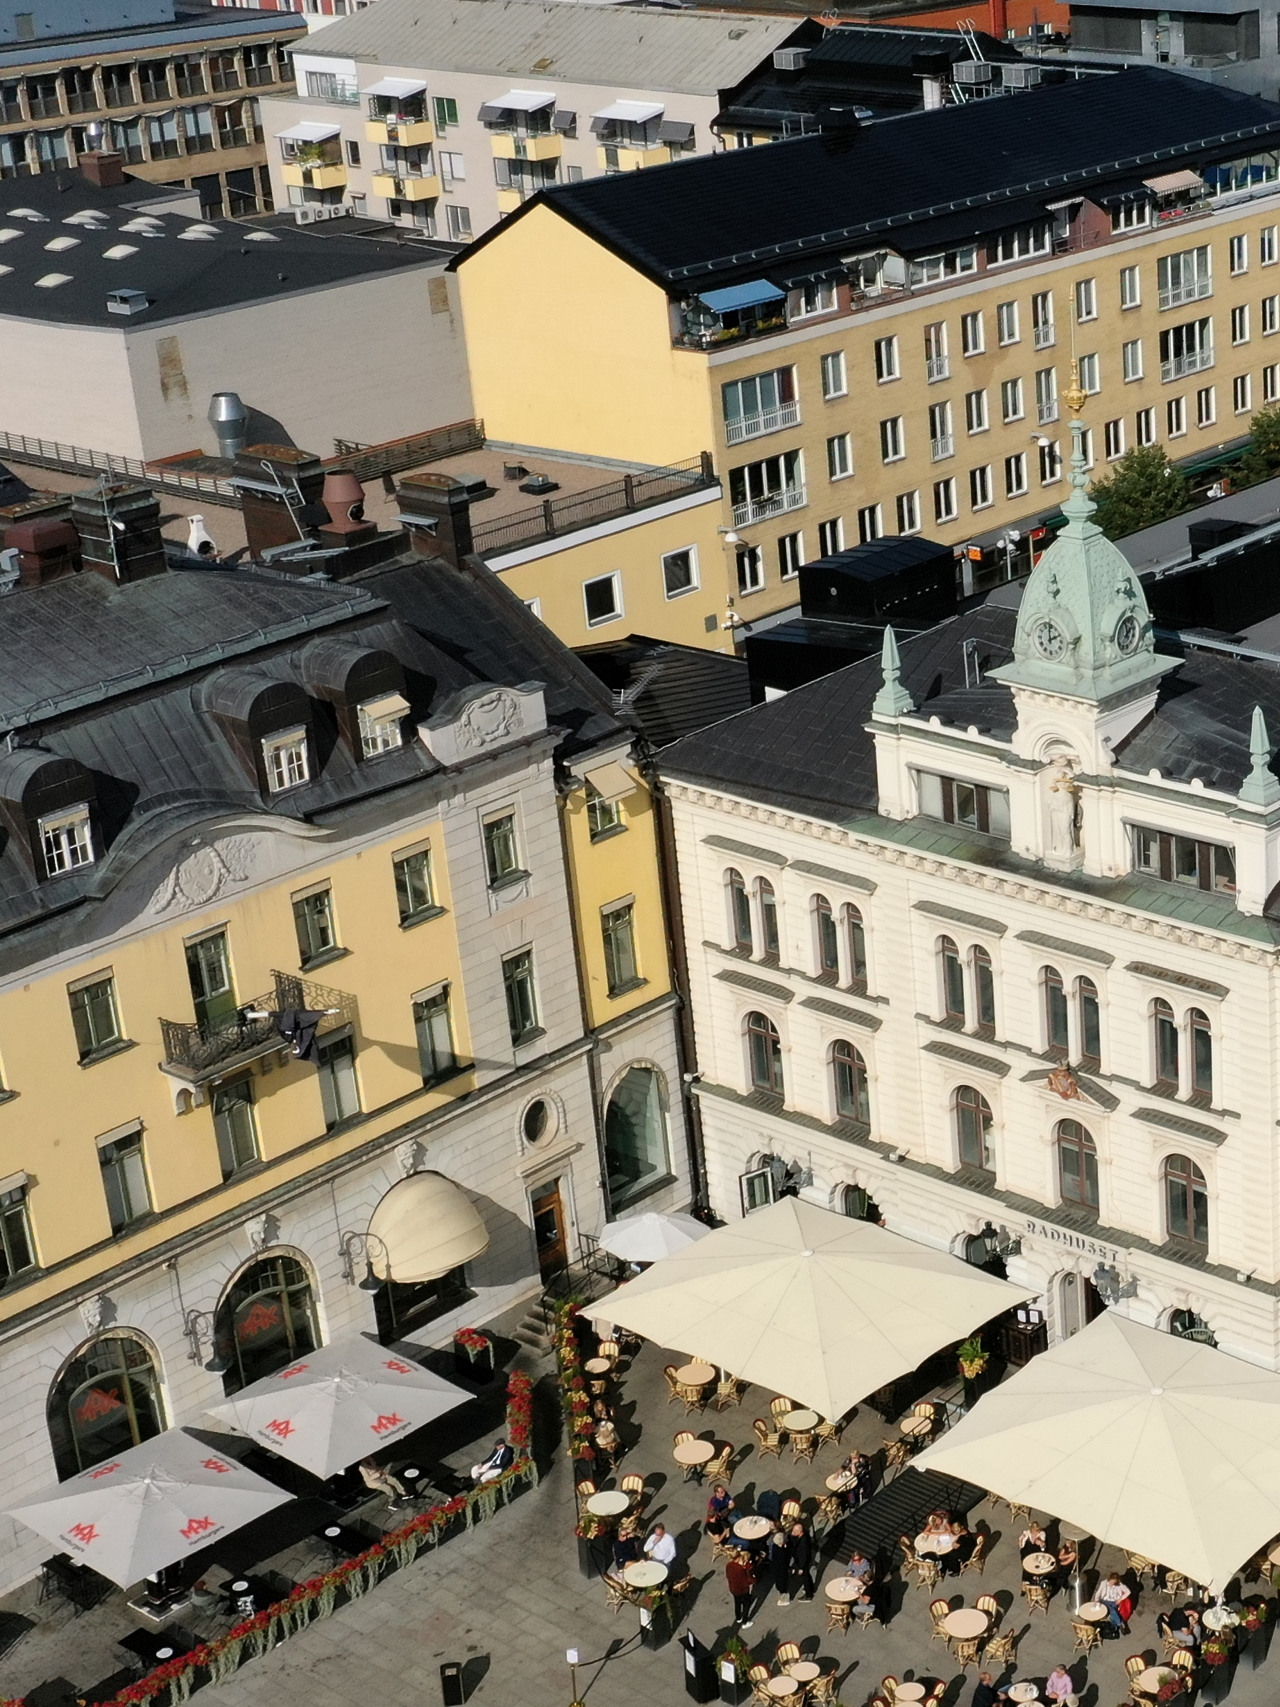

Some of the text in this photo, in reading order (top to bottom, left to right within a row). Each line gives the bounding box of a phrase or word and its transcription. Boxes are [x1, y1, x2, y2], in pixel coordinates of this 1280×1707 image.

[76, 1388, 121, 1427] MAX
[265, 1419, 296, 1439] MAX
[370, 1412, 404, 1434] MAX
[68, 1522, 101, 1545] MAX
[179, 1516, 217, 1539] MAX
